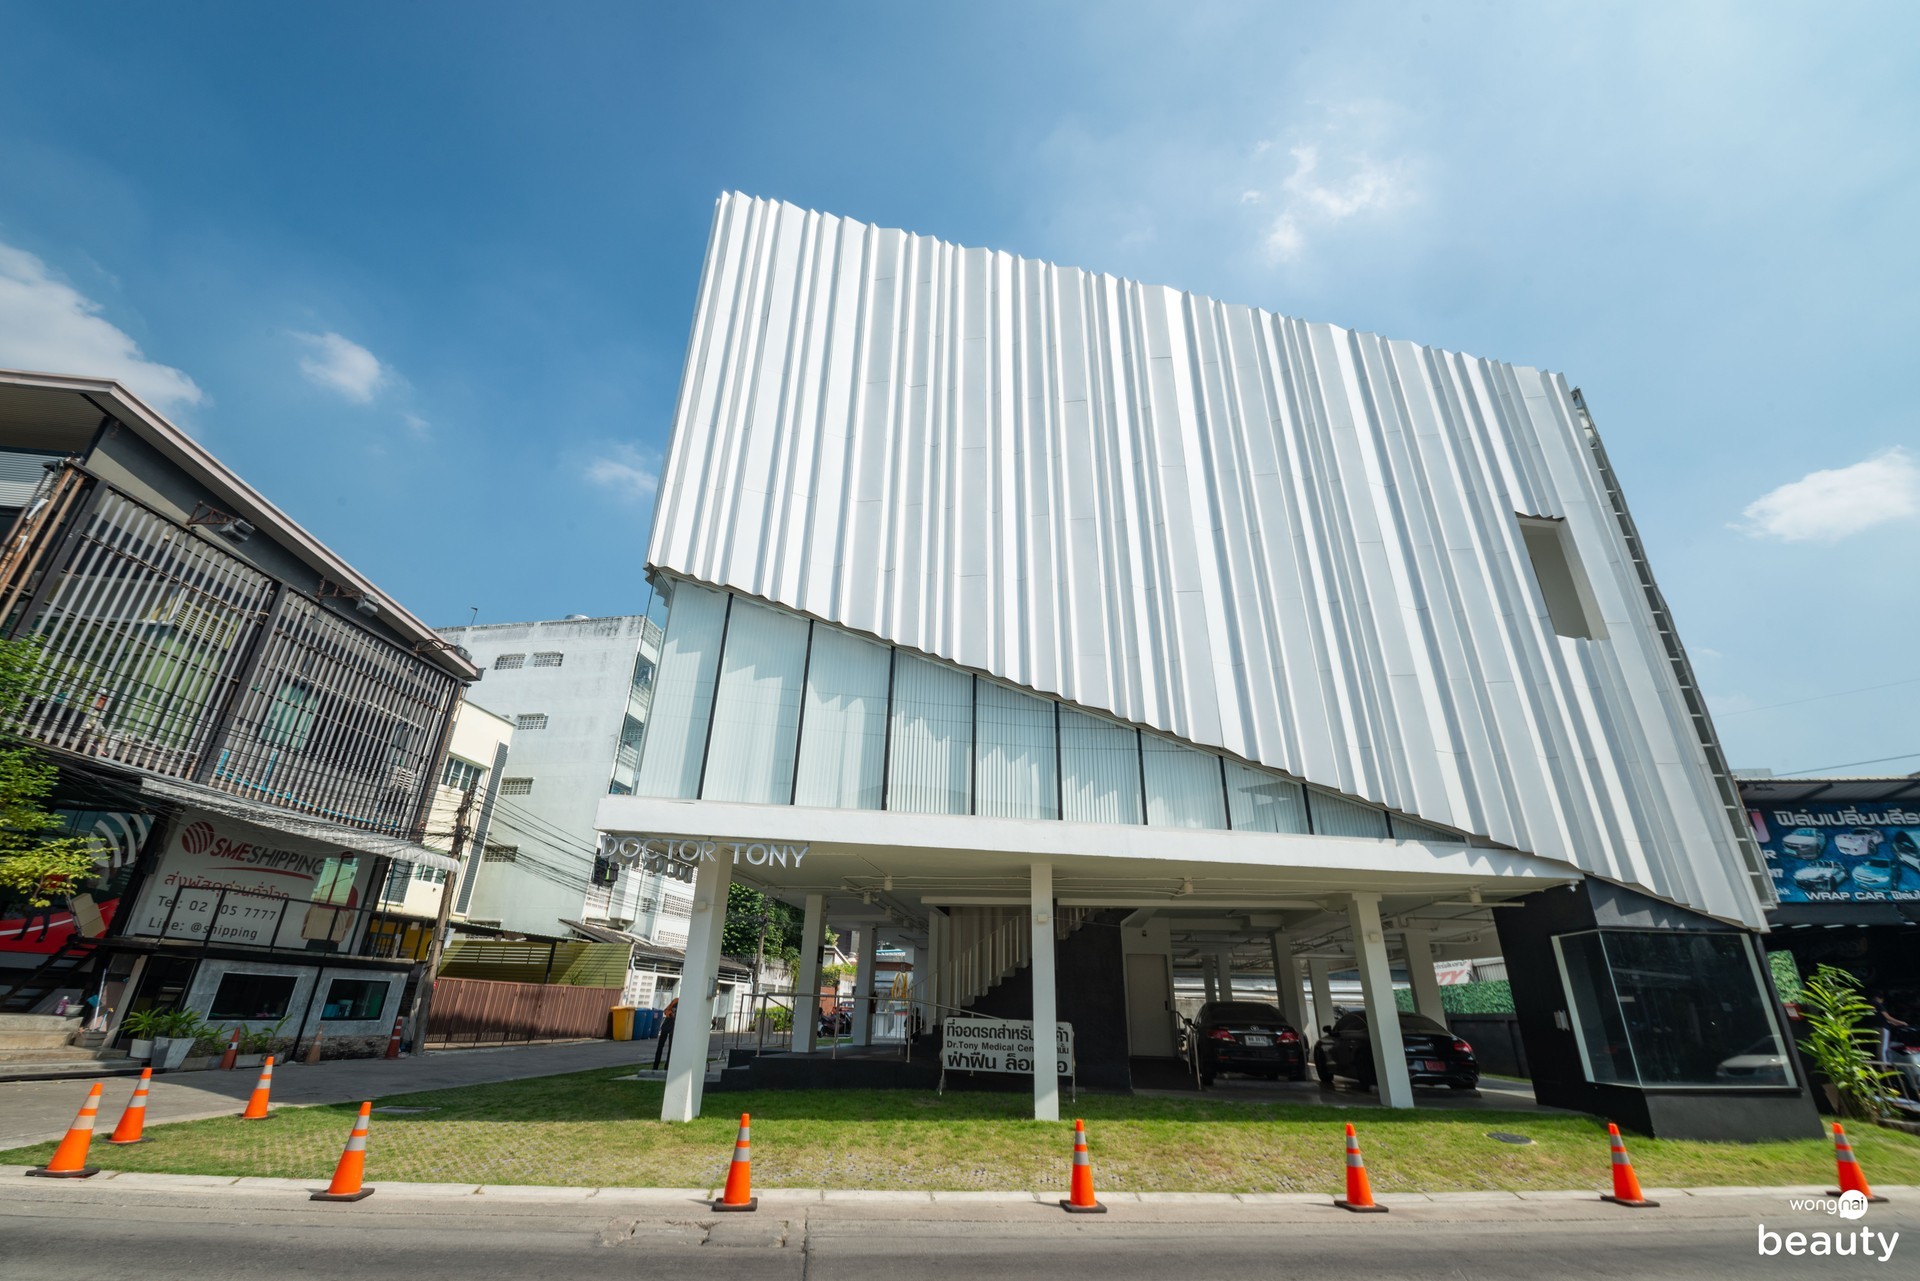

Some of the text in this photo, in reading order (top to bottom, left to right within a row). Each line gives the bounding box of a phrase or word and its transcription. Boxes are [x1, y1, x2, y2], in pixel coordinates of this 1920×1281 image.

[600, 835, 809, 868] DOCTOR TONY
[1805, 891, 1850, 900] WRAP
[1854, 891, 1886, 900] CAR
[158, 895, 182, 910] Te:
[189, 899, 207, 912] 02
[244, 907, 276, 920] 7777
[946, 1041, 979, 1051] Dr.Tony
[981, 1042, 1015, 1052] Medical
[947, 1051, 997, 1069] ฝ่าฝืน
